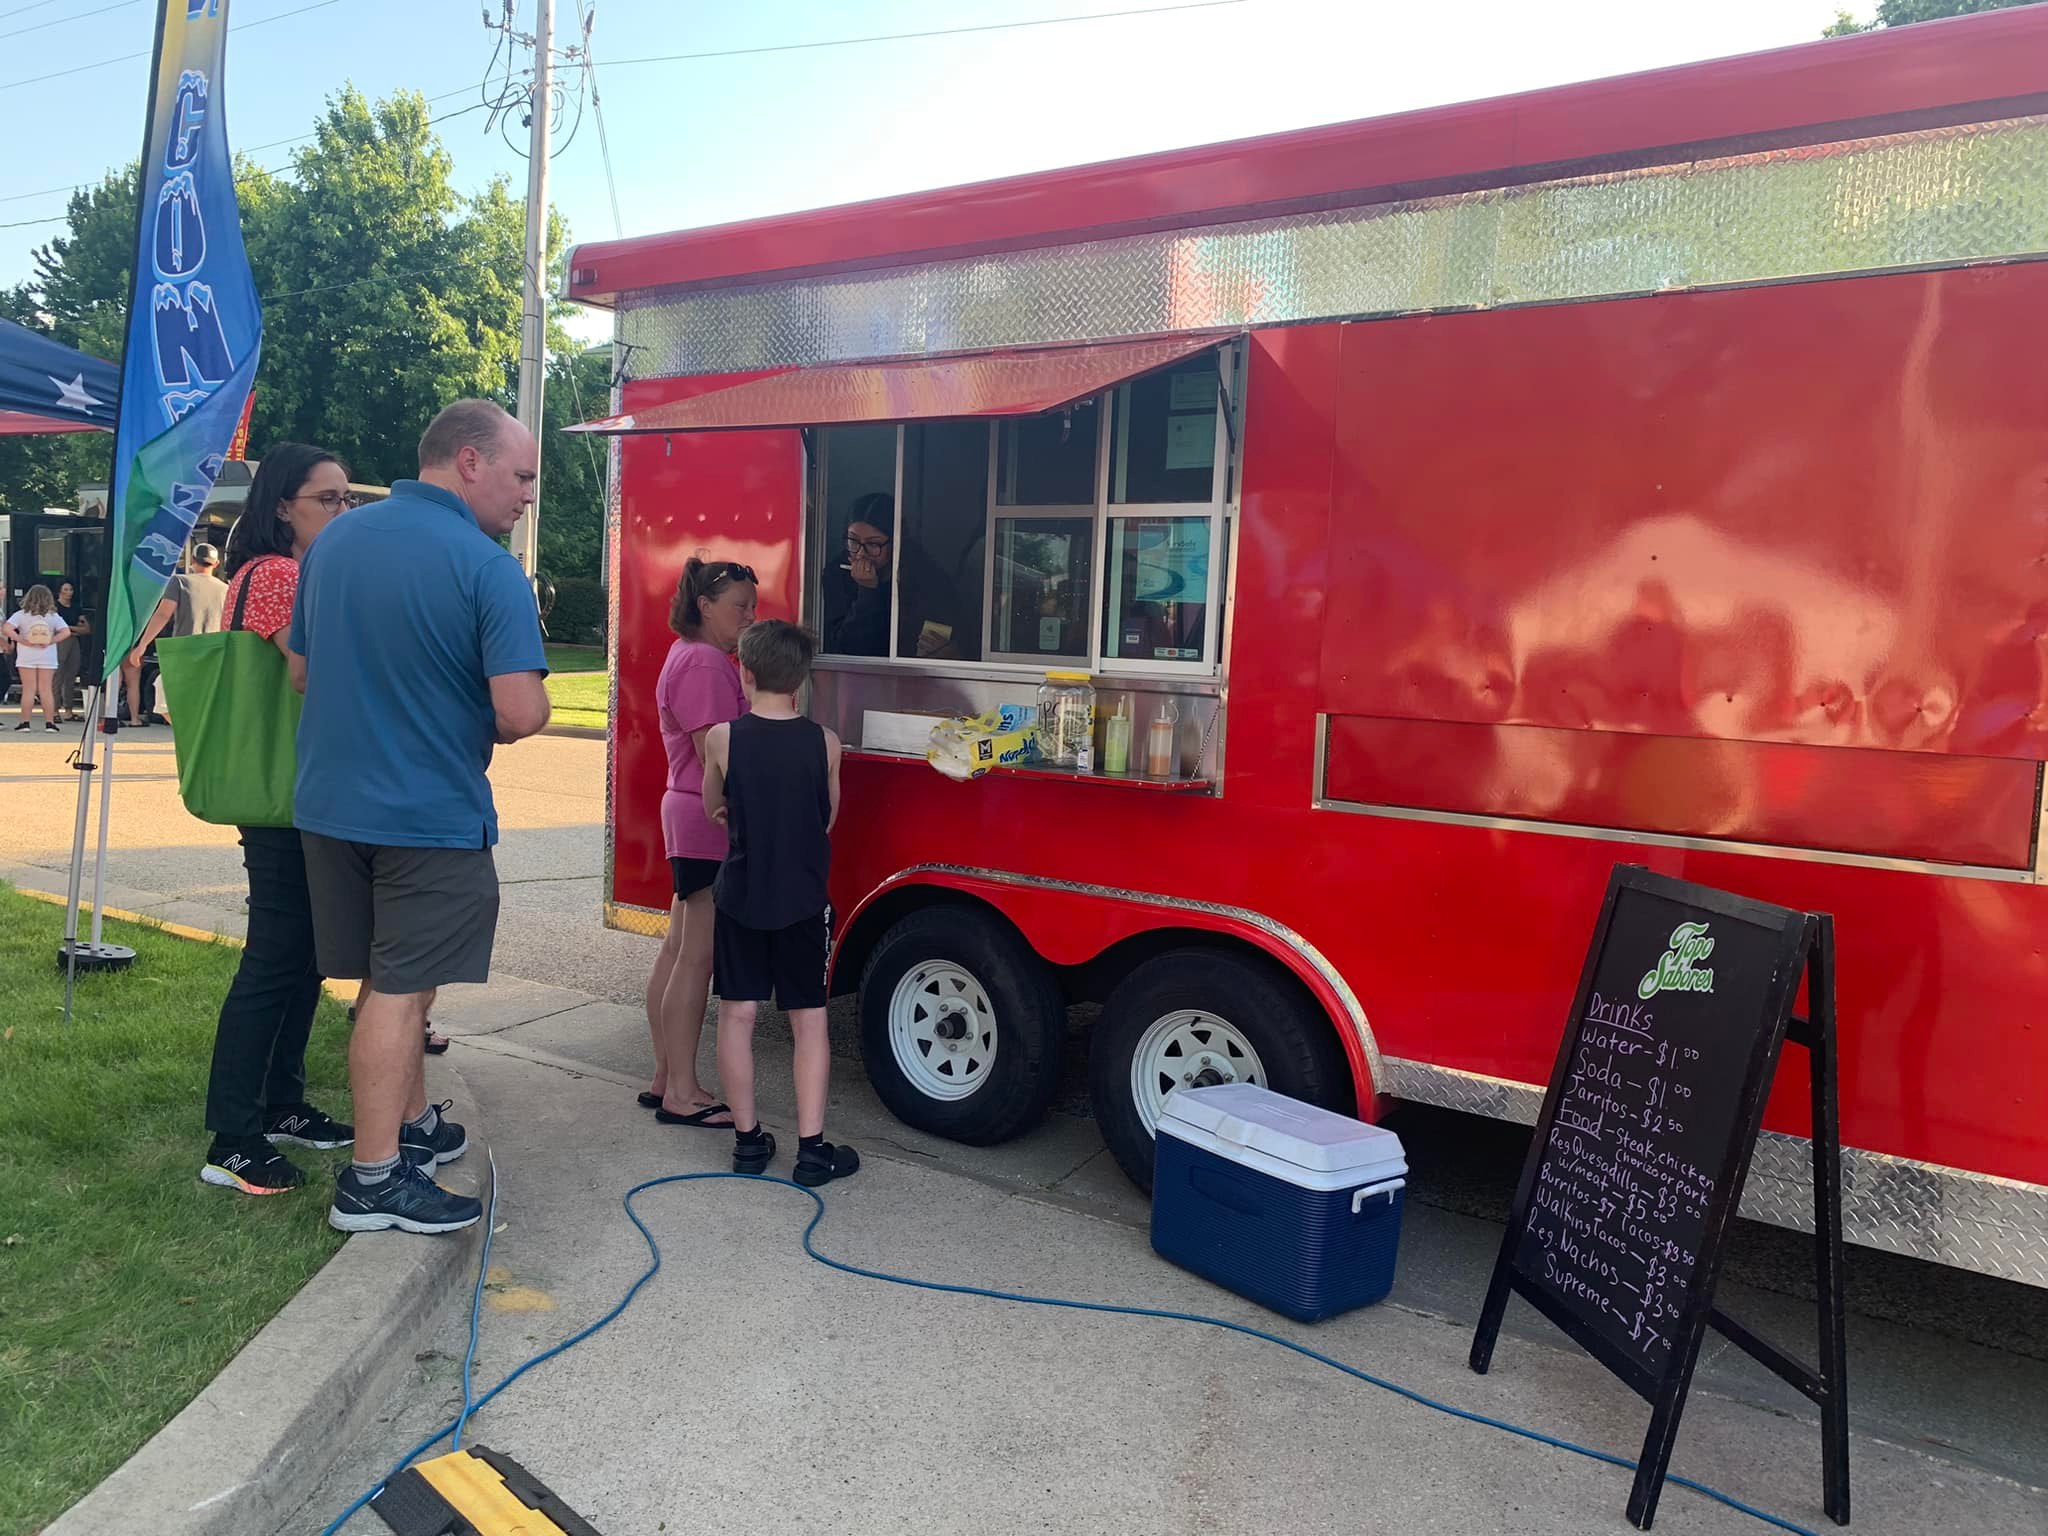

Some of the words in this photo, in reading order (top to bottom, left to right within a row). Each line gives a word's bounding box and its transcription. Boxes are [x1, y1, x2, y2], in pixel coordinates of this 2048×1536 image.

[1669, 921, 1715, 967] Topo
[1638, 951, 1715, 1000] Sabores
[1589, 992, 1654, 1031] Drinks
[1581, 1027, 1643, 1055] Water
[1577, 1048, 1622, 1090] Soda
[1560, 1098, 1604, 1136] Food
[1566, 1074, 1628, 1119] Jarritos
[1540, 1162, 1590, 1205] Burritos
[1572, 1136, 1639, 1193] Quesadilla
[1660, 1172, 1675, 1185] or
[1560, 1228, 1620, 1286] Nachos
[1544, 1252, 1610, 1313] Supreme
